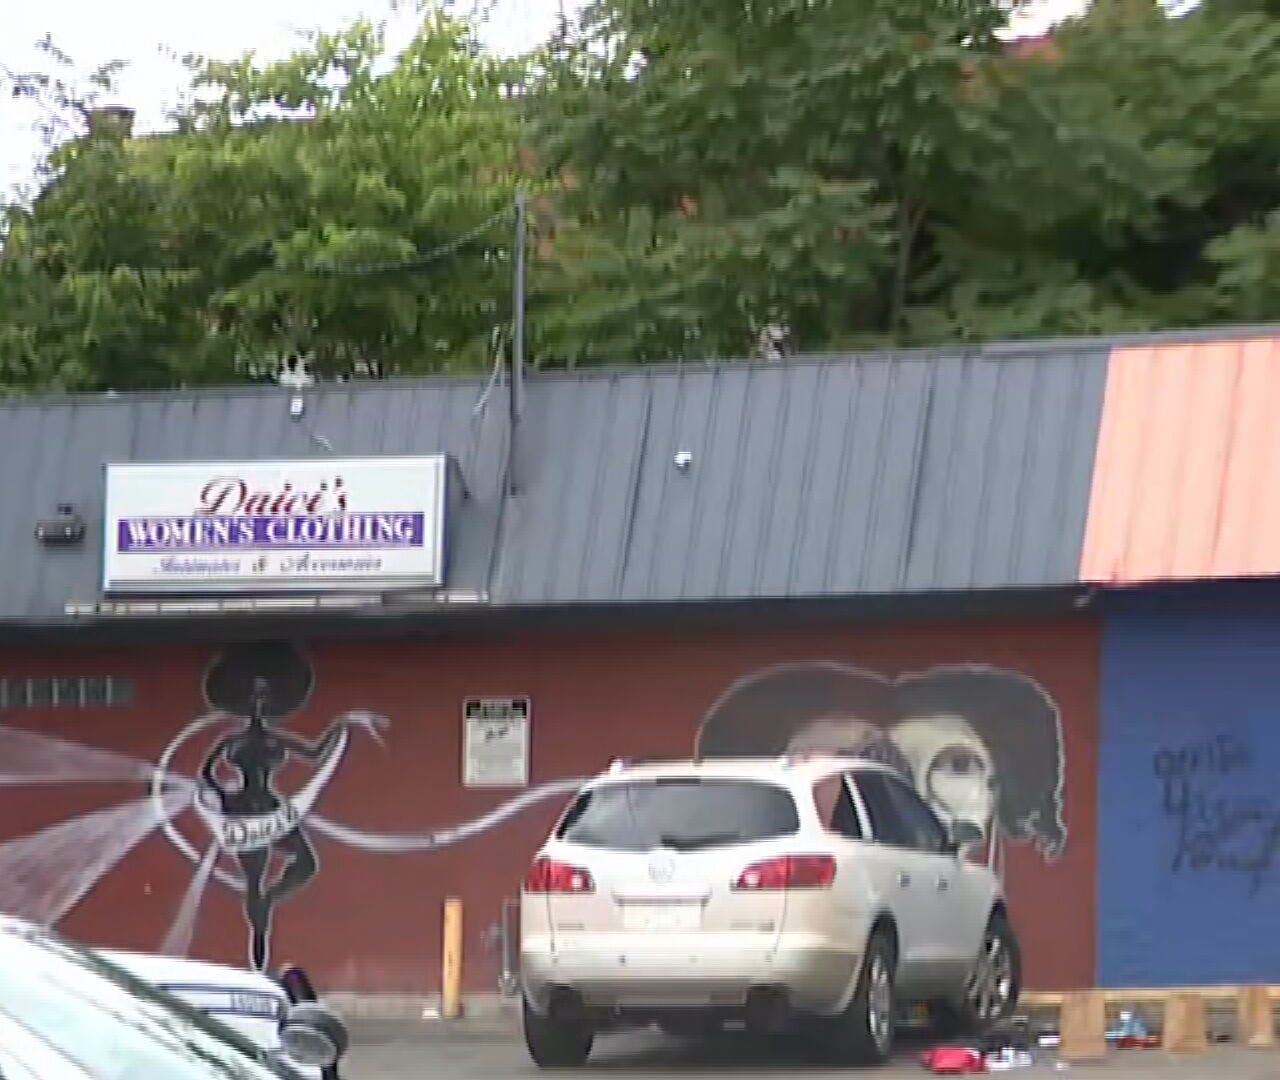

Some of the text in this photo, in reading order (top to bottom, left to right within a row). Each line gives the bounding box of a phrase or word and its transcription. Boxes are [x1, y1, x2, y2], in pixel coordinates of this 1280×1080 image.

[194, 476, 347, 516] Daici's
[126, 512, 414, 550] WOMEN'S CLOTHING
